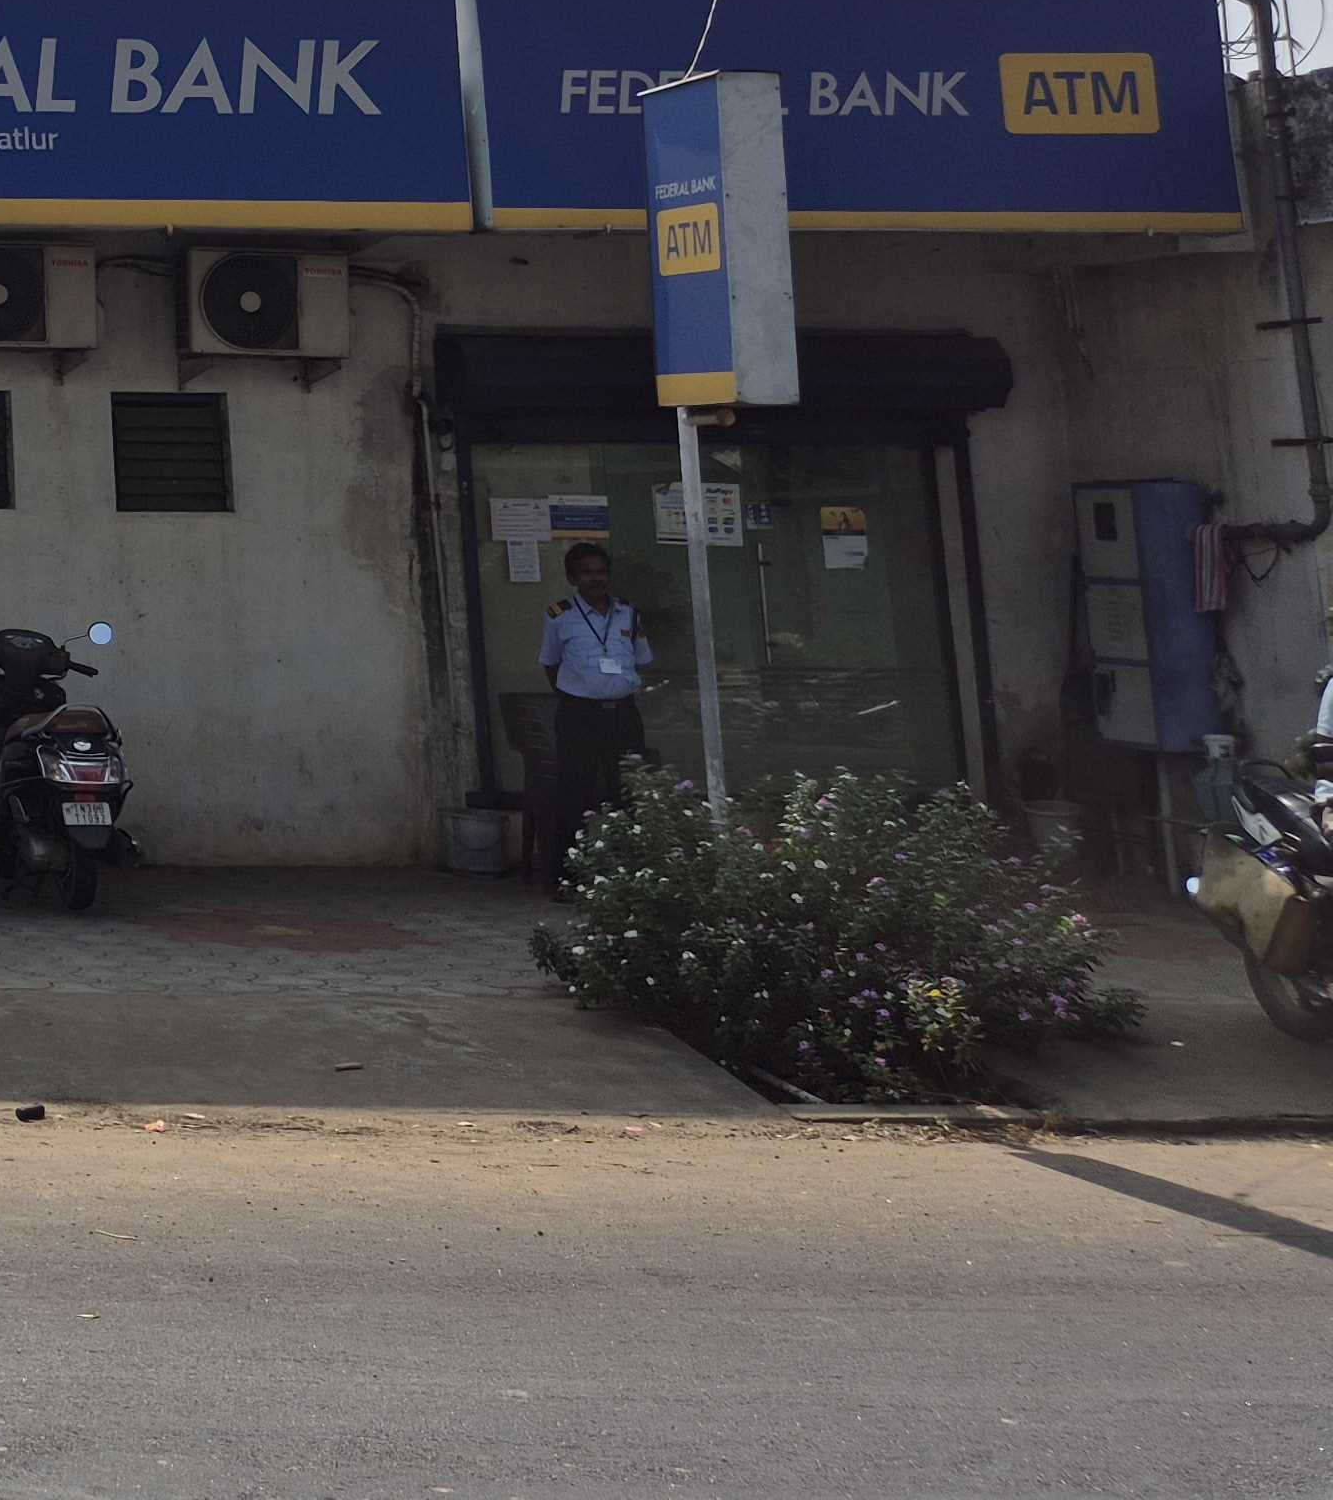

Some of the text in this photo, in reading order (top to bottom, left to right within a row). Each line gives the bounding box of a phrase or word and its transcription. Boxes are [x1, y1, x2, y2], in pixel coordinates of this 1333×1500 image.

[111, 37, 381, 115] BANK
[810, 71, 969, 116] BANK
[1023, 71, 1141, 116] ATM
[654, 175, 716, 200] FEDERAL BANK
[666, 219, 712, 260] ATM
